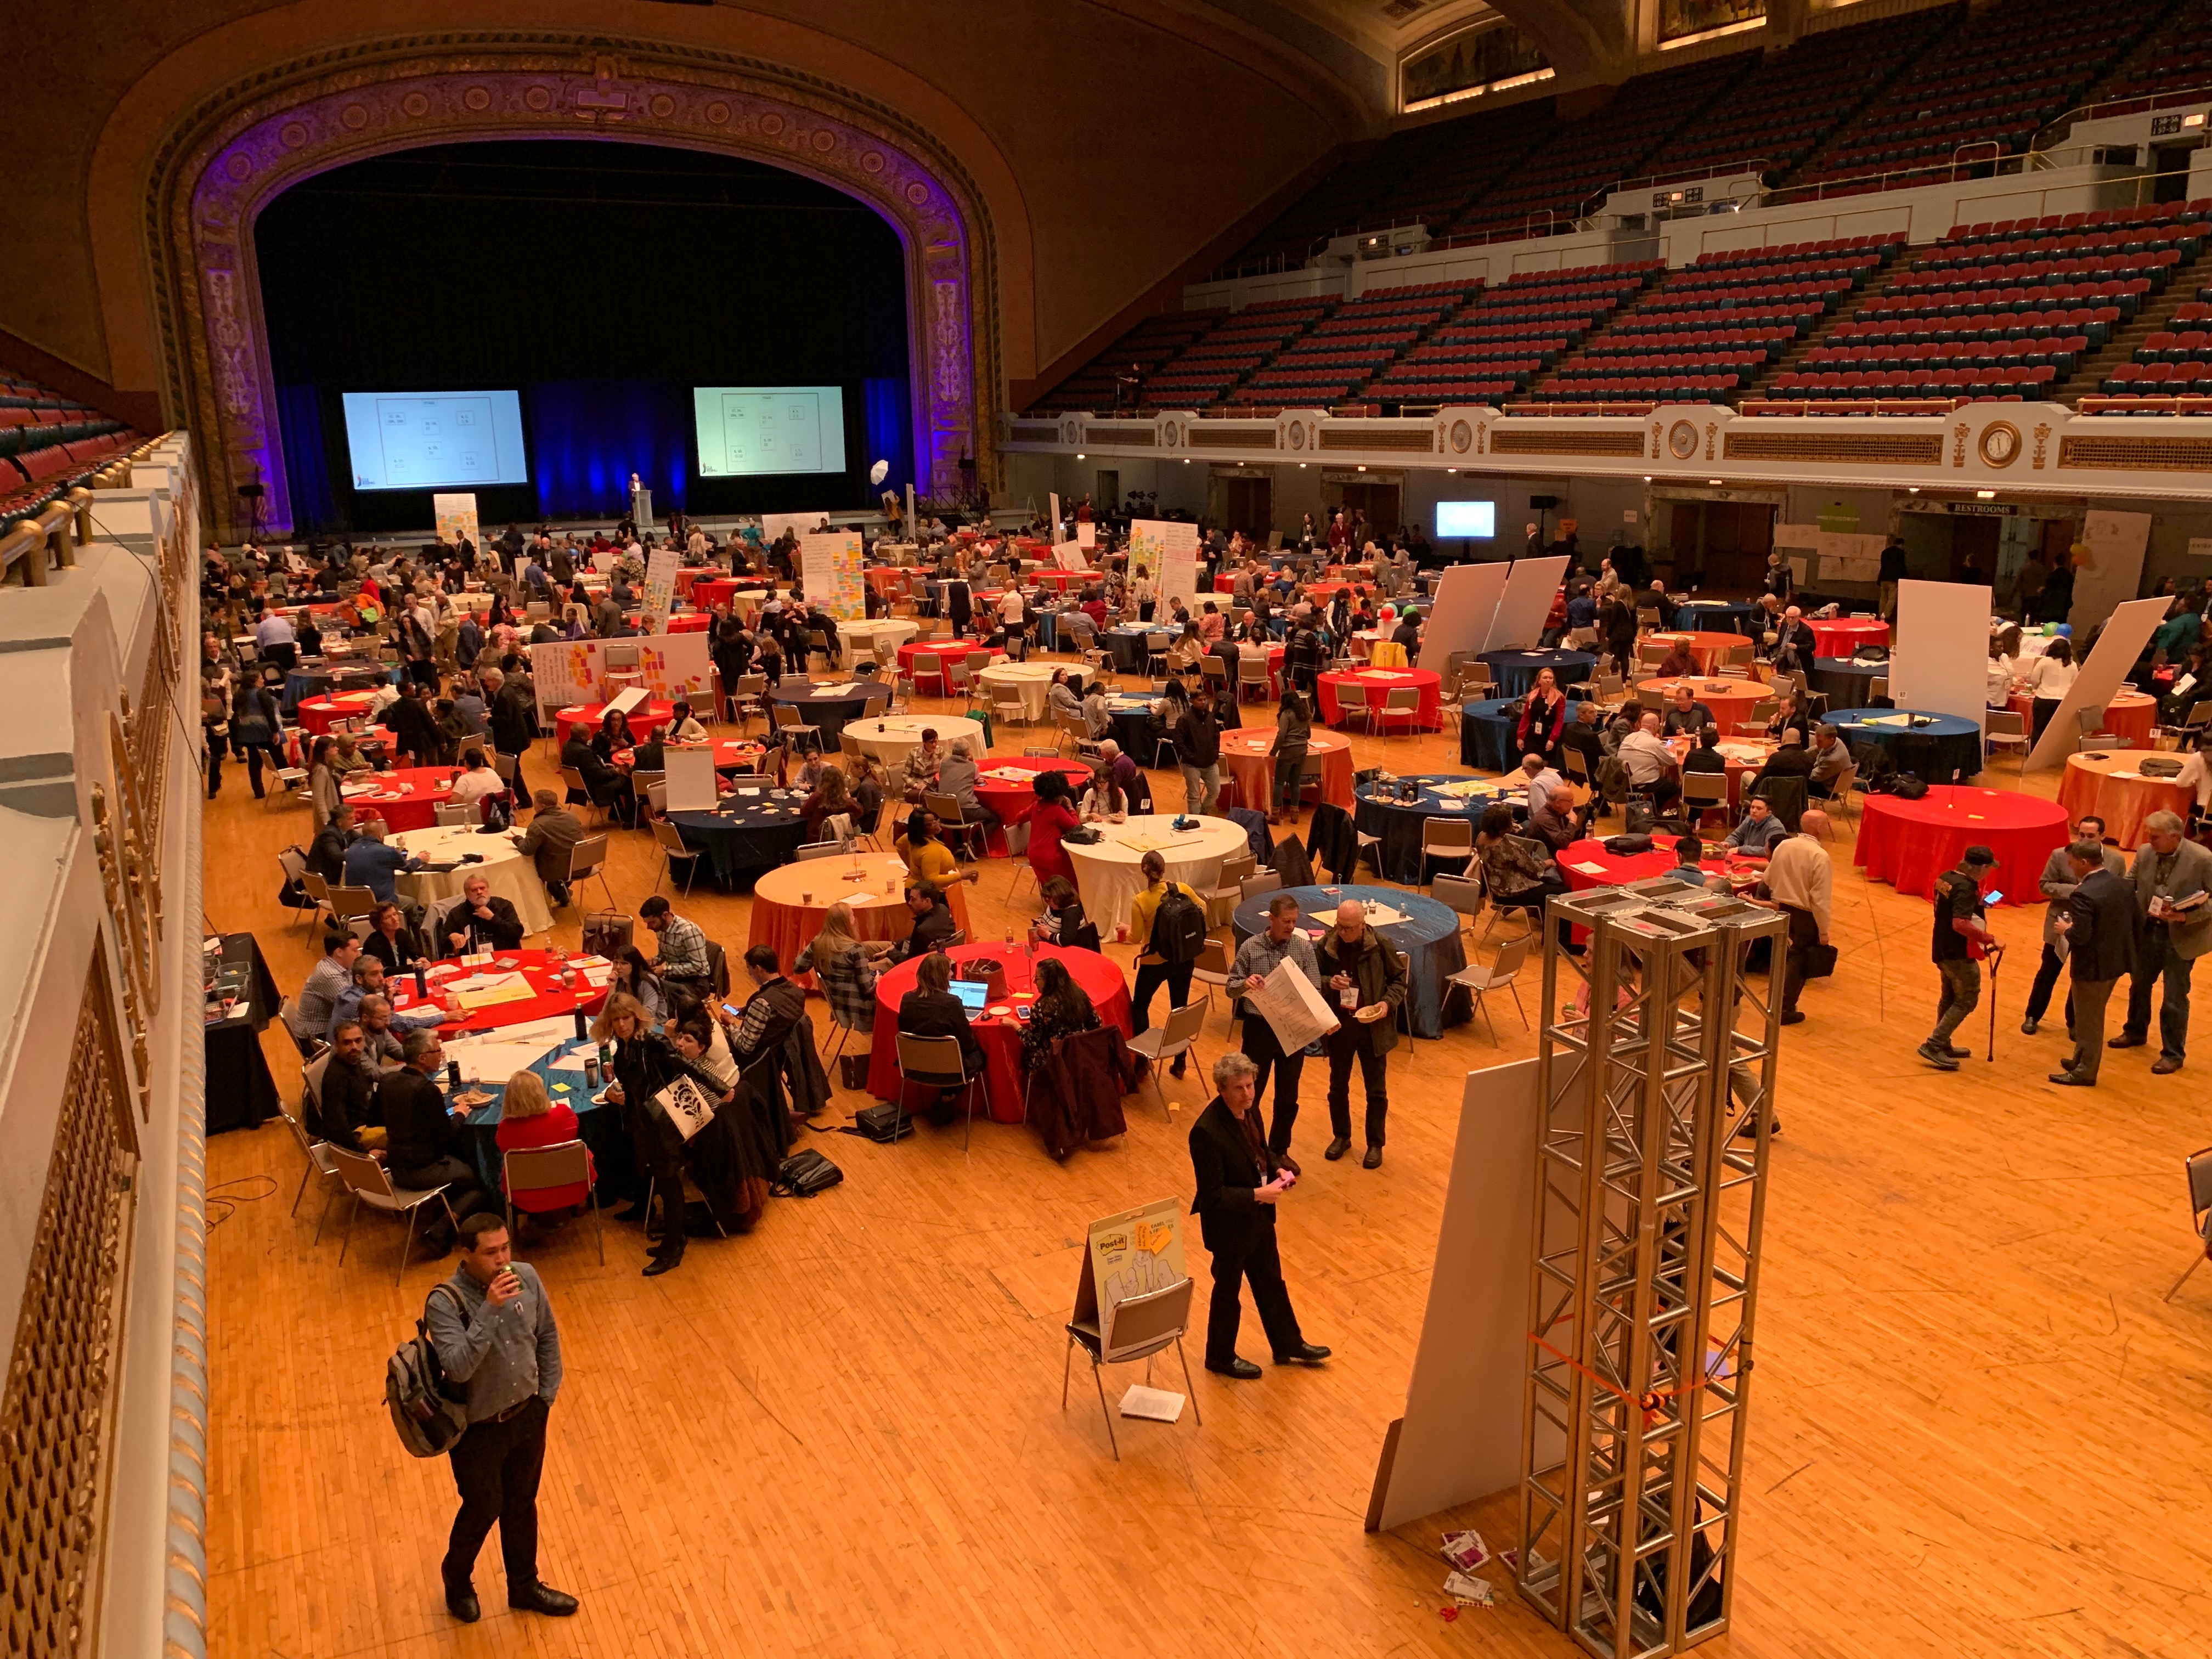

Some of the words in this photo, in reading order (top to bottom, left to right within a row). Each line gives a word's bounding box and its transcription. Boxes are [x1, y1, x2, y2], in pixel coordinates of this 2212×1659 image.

[1955, 504, 2010, 514] RESTROOMS
[850, 840, 857, 848] 88
[1150, 1221, 1165, 1229] EASEL
[1099, 1237, 1125, 1250] Post-it
